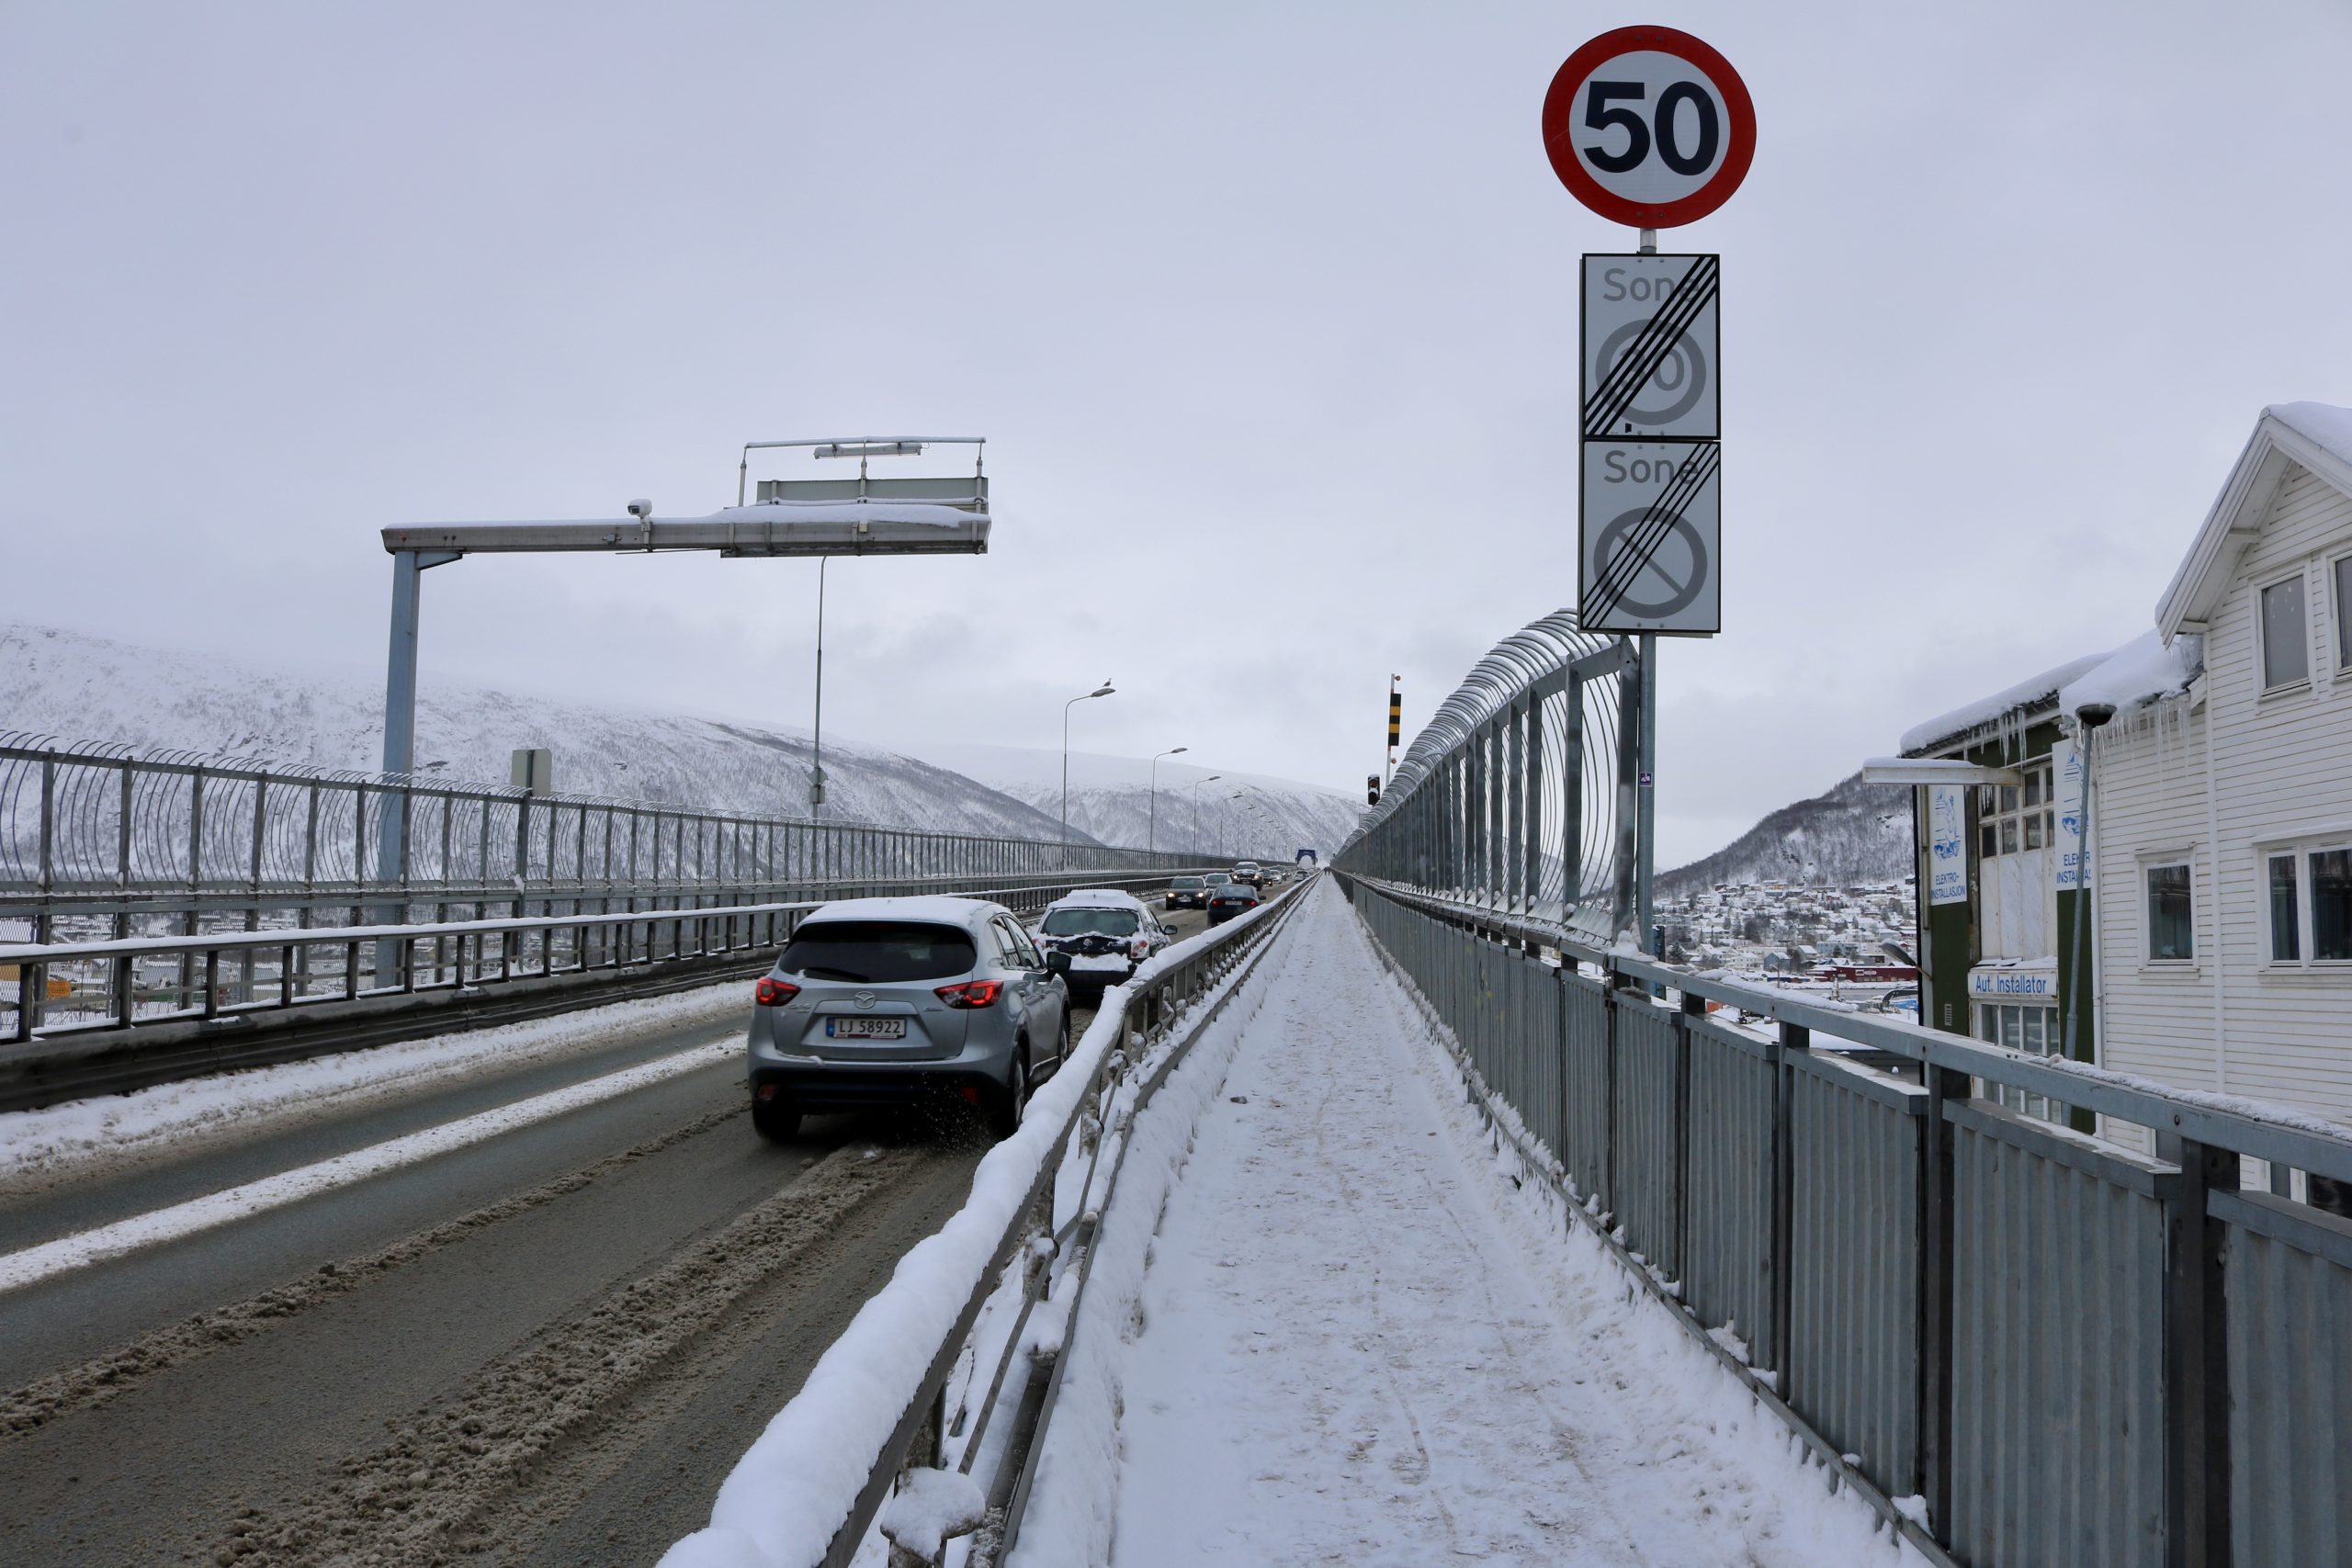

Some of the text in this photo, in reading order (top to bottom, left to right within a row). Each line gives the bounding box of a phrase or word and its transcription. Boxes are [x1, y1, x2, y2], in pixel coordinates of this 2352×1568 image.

[1583, 81, 1719, 175] 50
[1603, 450, 1700, 485] Sone
[1935, 872, 1960, 886] ELEKTRO-
[1975, 975, 2047, 993] Aut. Installatør
[839, 1020, 900, 1033] LJ 58922
